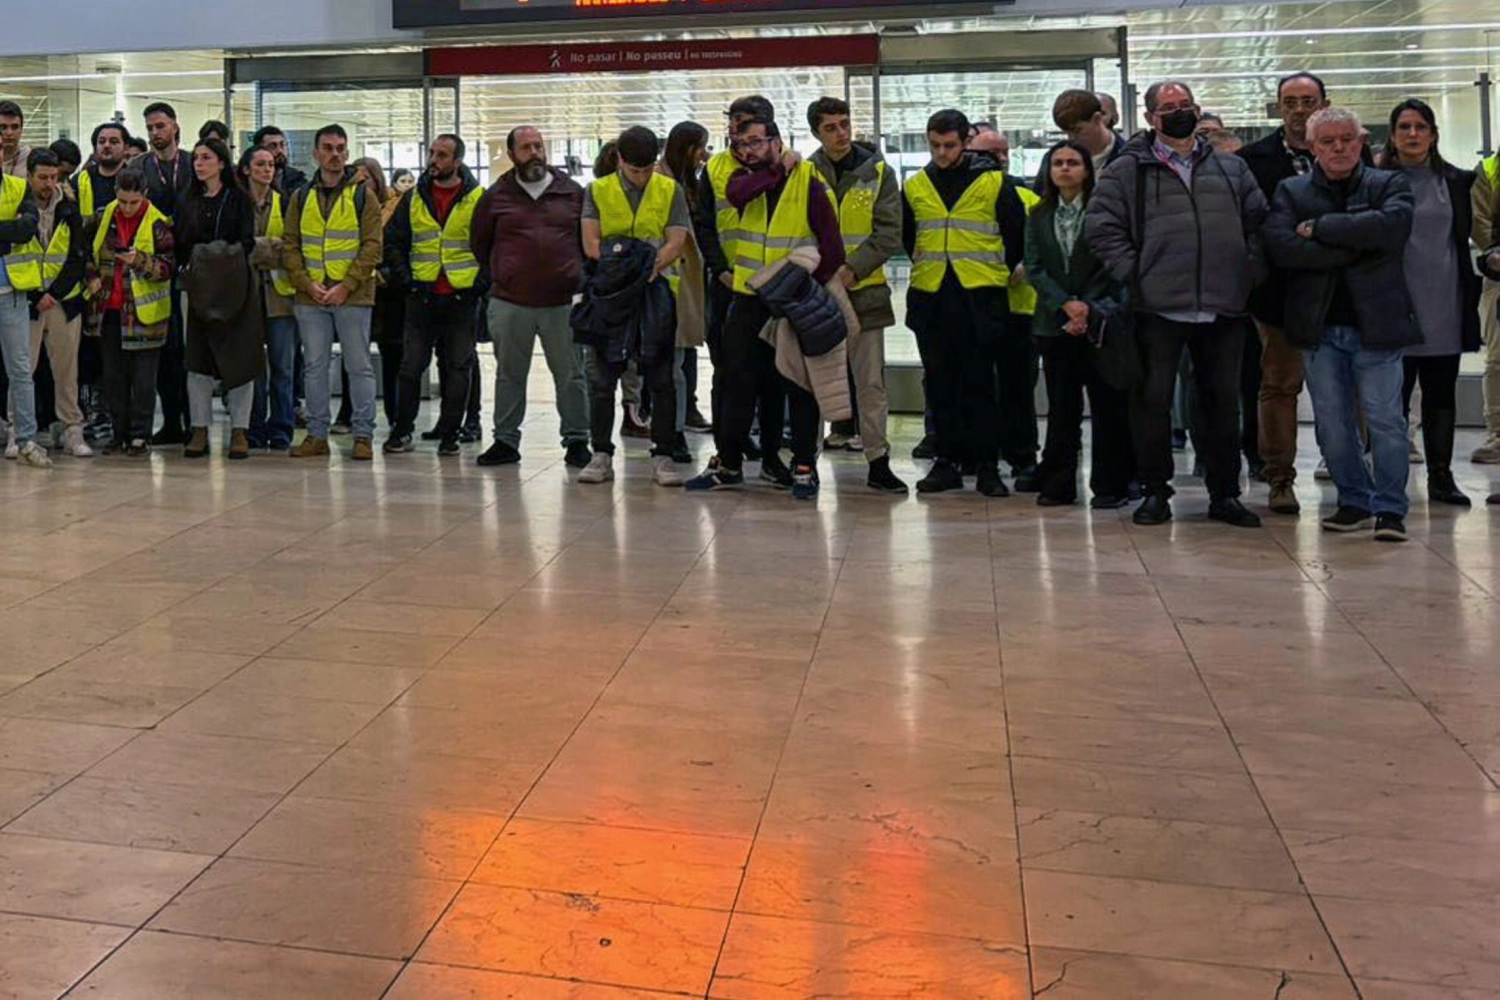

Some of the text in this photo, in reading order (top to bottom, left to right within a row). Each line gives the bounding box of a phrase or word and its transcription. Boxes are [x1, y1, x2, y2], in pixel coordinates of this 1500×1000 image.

[570, 53, 584, 62] No
[587, 53, 617, 64] pasar
[626, 51, 641, 61] No
[644, 51, 682, 62] passeu
